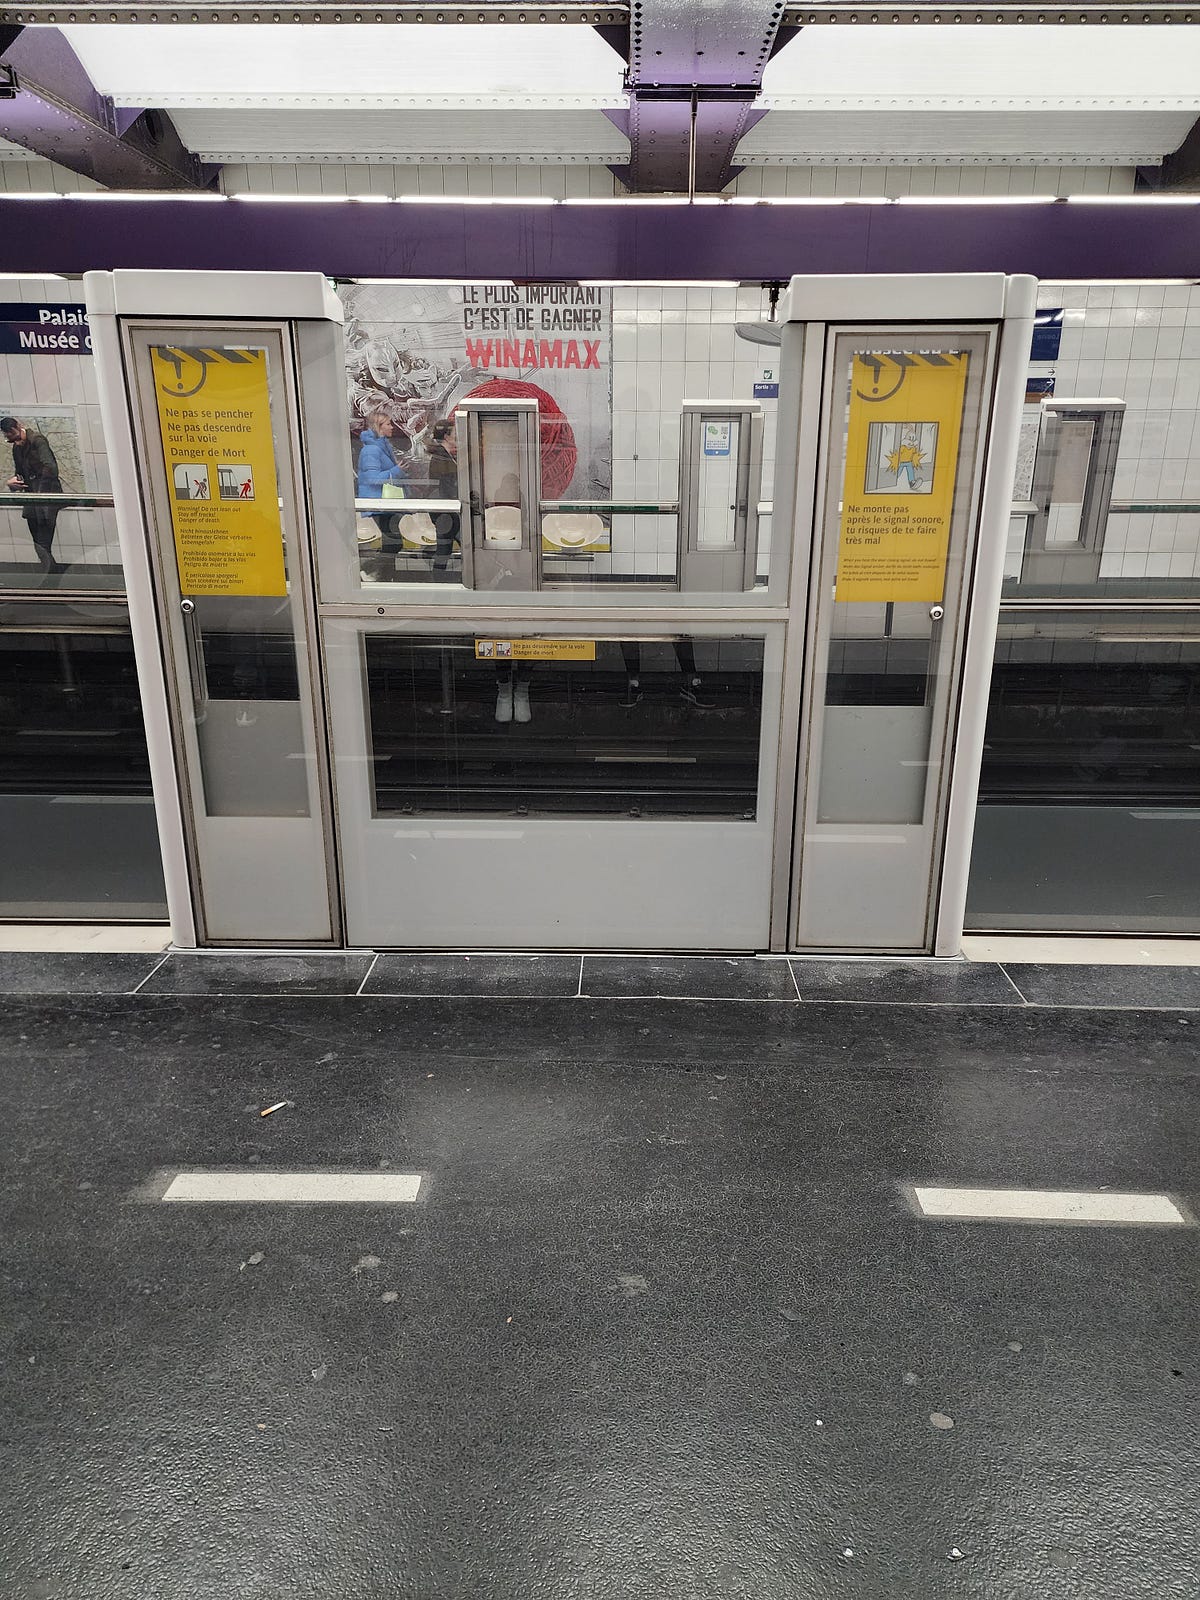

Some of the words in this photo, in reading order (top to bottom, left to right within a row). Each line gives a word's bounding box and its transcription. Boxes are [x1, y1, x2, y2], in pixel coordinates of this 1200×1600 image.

[463, 286, 478, 304] LE
[484, 286, 519, 304] PLUS
[526, 286, 602, 304] IMPORTANT
[464, 308, 510, 330] C'EST
[516, 308, 534, 331] DE
[542, 308, 602, 331] GAGNER
[20, 331, 80, 348] Musée
[466, 338, 601, 370] WINAMAX
[166, 408, 179, 417] Ne
[182, 410, 198, 420] pas
[214, 409, 253, 419] pencher
[168, 423, 181, 431] Ne
[184, 424, 200, 433] pas
[203, 423, 252, 432] descendre
[186, 434, 195, 443] la
[197, 434, 217, 443] voie
[171, 447, 204, 458] Danger
[208, 448, 219, 457] de
[222, 448, 246, 457] Mort
[894, 506, 909, 514] pas
[847, 516, 870, 525] après
[884, 516, 909, 525] signal
[912, 517, 944, 525] sonore,
[858, 526, 889, 535] risques
[917, 526, 936, 534] faire
[846, 536, 862, 544] très
